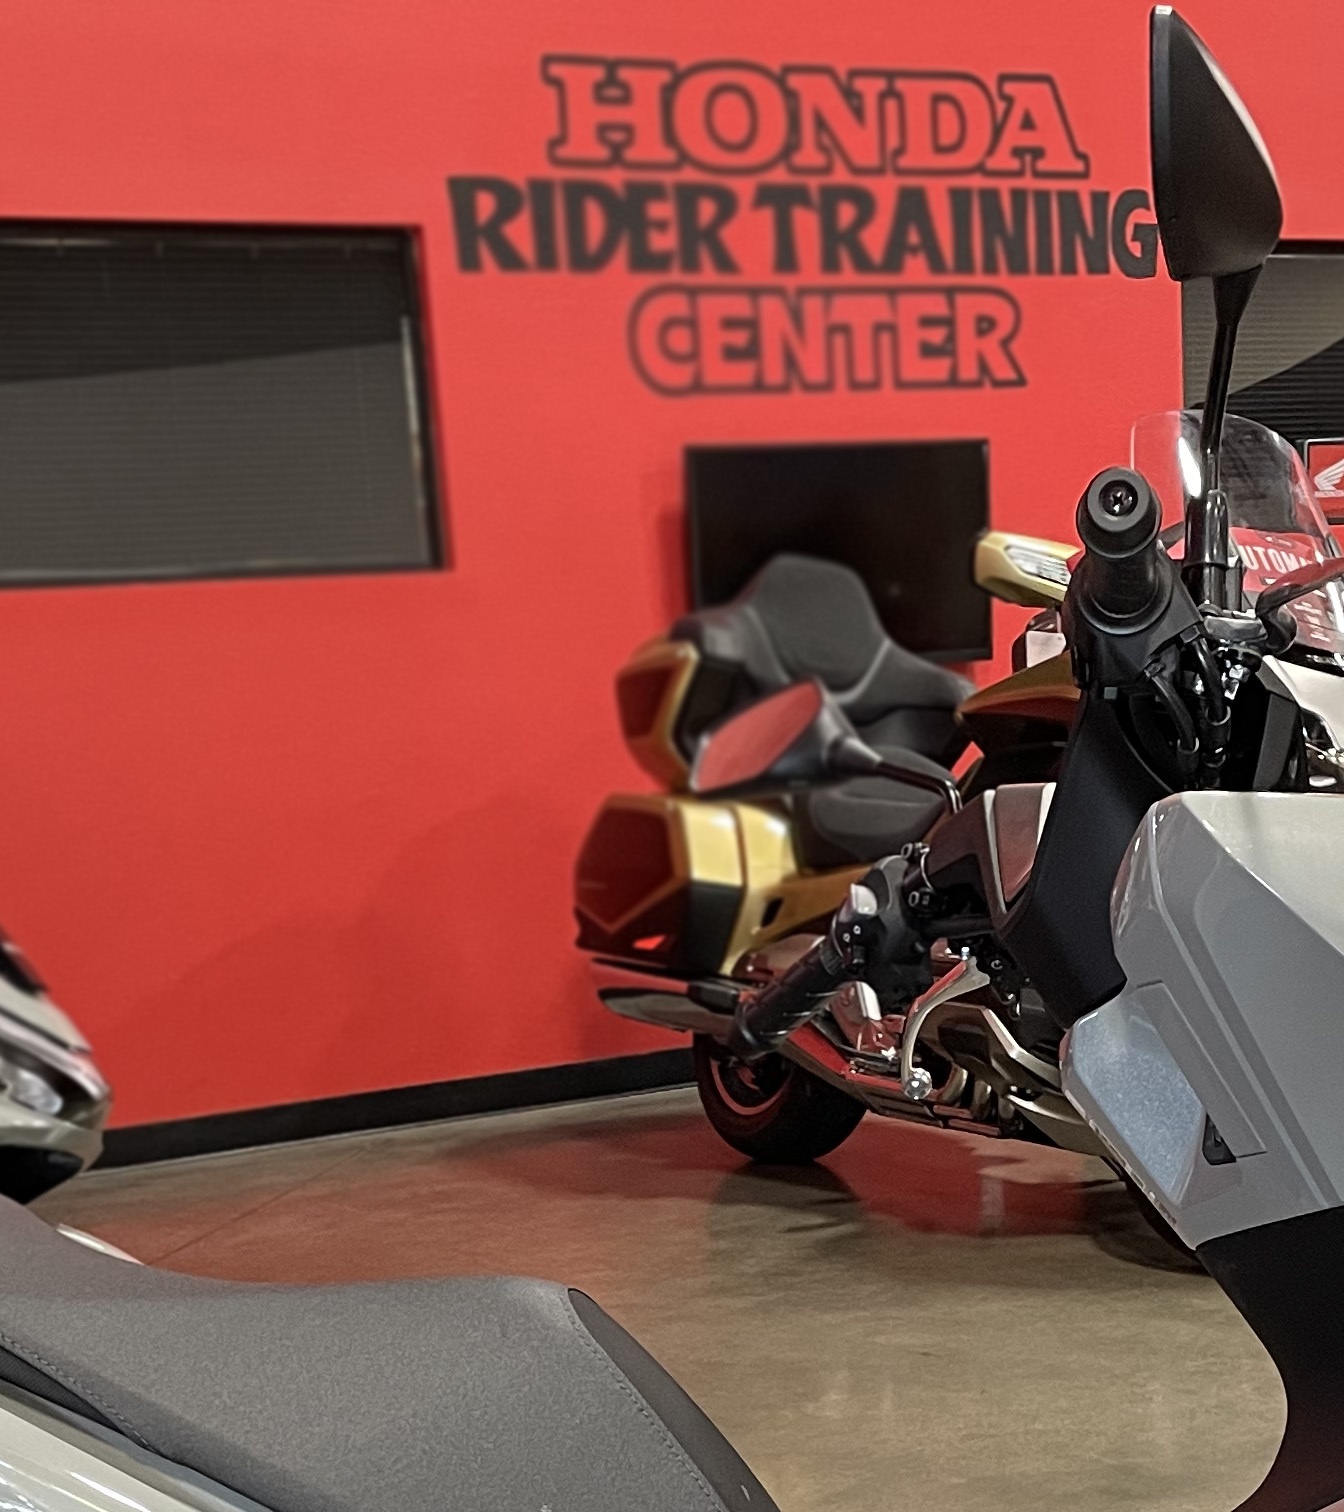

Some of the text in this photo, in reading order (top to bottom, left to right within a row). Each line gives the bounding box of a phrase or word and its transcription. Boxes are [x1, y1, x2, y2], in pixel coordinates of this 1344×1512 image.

[540, 53, 1090, 179] HONDA
[446, 174, 1159, 279] RIDER TRAINING
[627, 283, 1028, 398] CENTER
